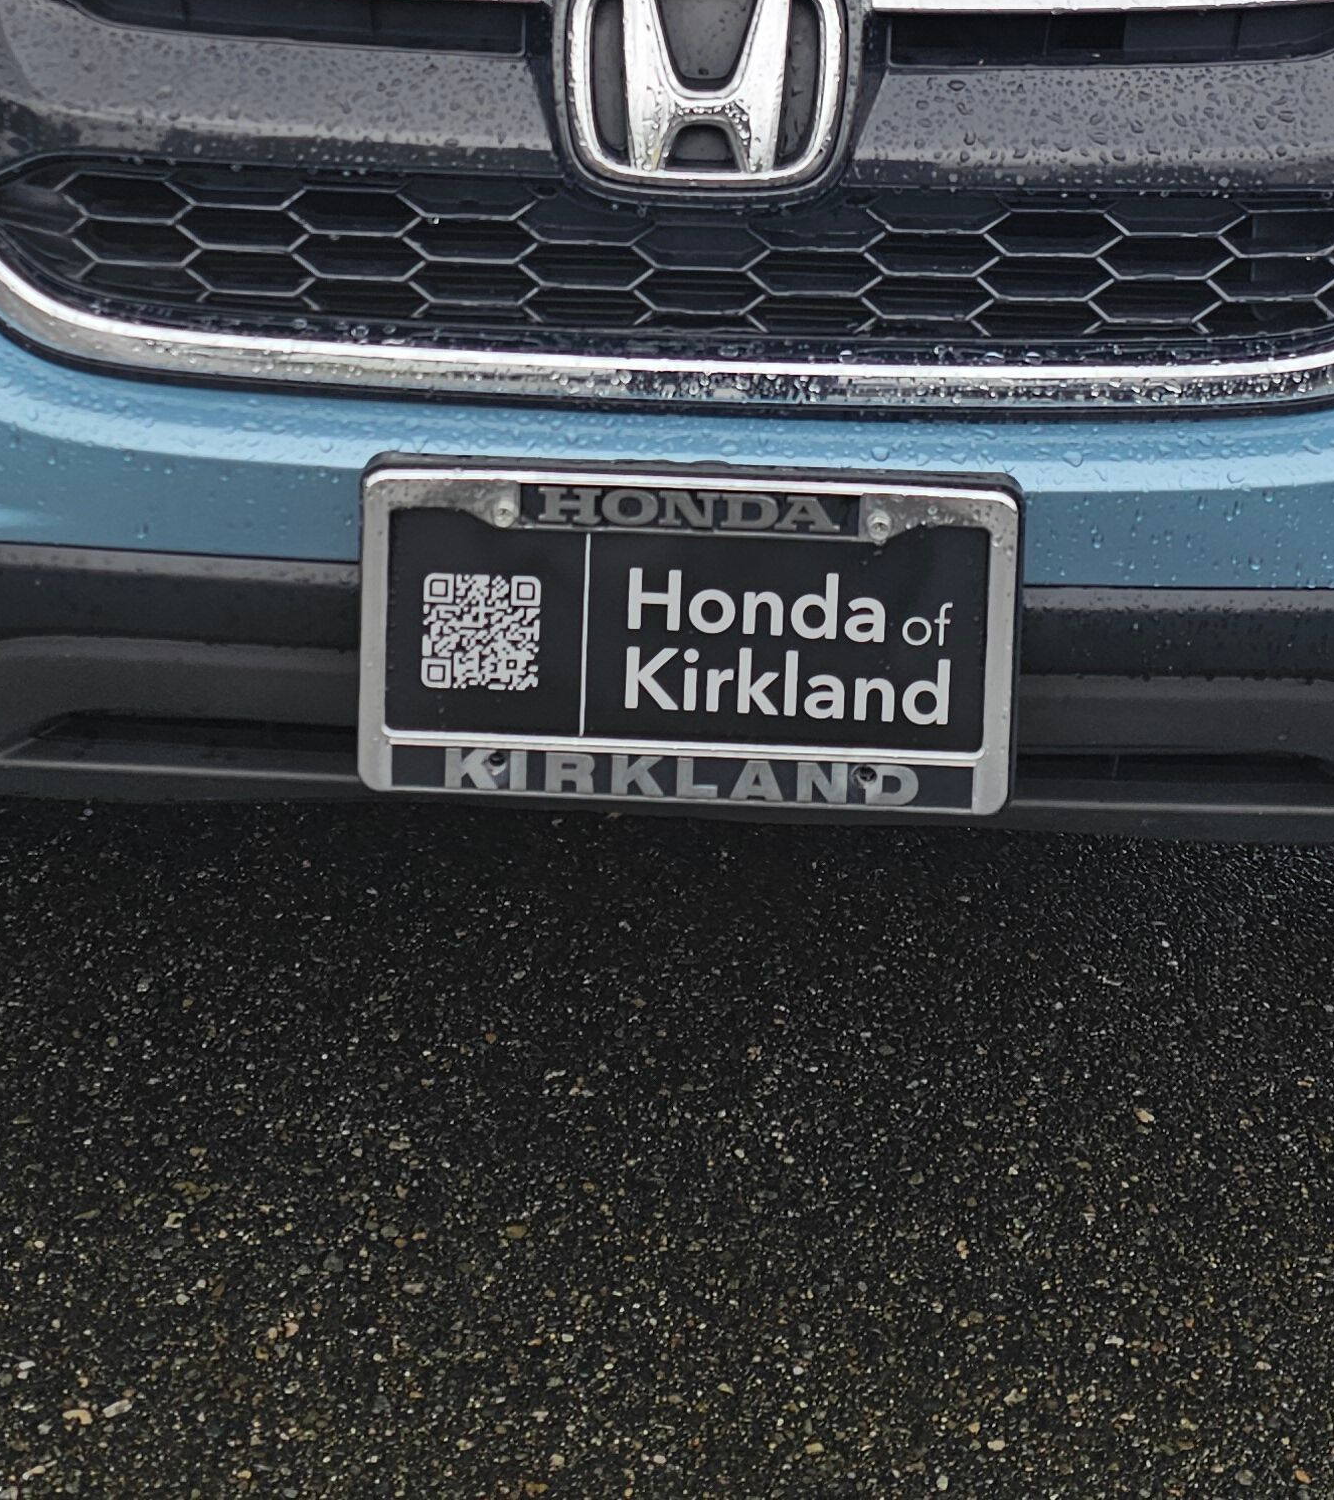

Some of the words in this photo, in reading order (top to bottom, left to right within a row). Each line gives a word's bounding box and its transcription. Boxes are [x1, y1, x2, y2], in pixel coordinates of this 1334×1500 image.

[538, 486, 840, 533] HONDA
[626, 566, 887, 644] Honda
[900, 602, 953, 647] of
[623, 645, 952, 726] Kirkland
[445, 748, 919, 806] KIRKLAND
